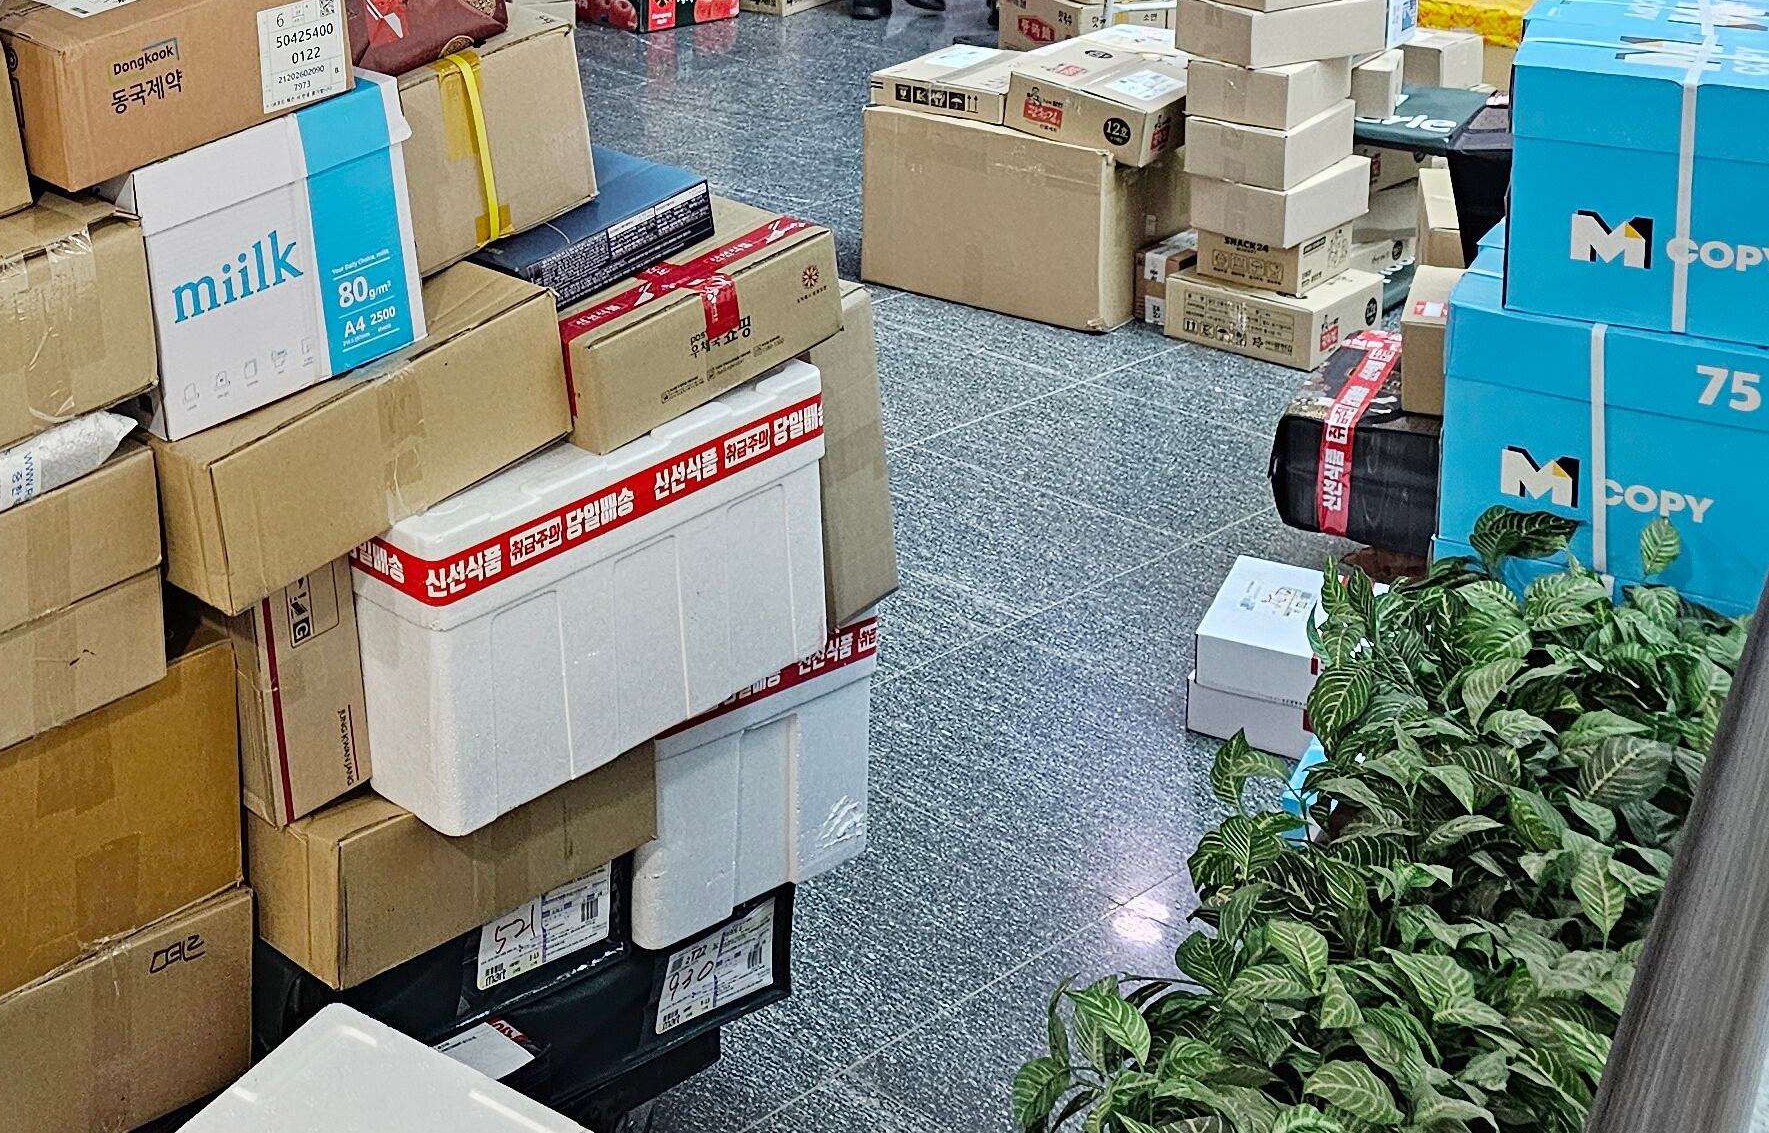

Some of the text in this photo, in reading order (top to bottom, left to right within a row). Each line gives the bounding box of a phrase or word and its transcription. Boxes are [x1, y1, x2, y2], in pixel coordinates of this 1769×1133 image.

[275, 13, 285, 29] 6
[275, 21, 335, 49] 50425400
[1143, 12, 1158, 22] 소면
[112, 43, 175, 77] Dongkook
[291, 45, 321, 65] 0122
[111, 67, 183, 115] 동국제약
[1105, 120, 1129, 139] 12호
[1569, 208, 1654, 270] M
[171, 229, 305, 325] miilk
[331, 263, 345, 275] Your
[343, 259, 358, 272] Daily
[343, 304, 397, 339] A4 2500
[1321, 447, 1345, 514] 신선식품
[1500, 444, 1581, 509] M
[424, 540, 503, 599] 신선식품
[510, 521, 561, 562] 취급주의
[565, 485, 636, 540] 당일배송
[654, 447, 719, 499] 신선식품
[725, 423, 771, 465] 취급주의
[1604, 478, 1715, 524] COPY
[493, 904, 535, 955] 521
[667, 960, 714, 1002] 930
